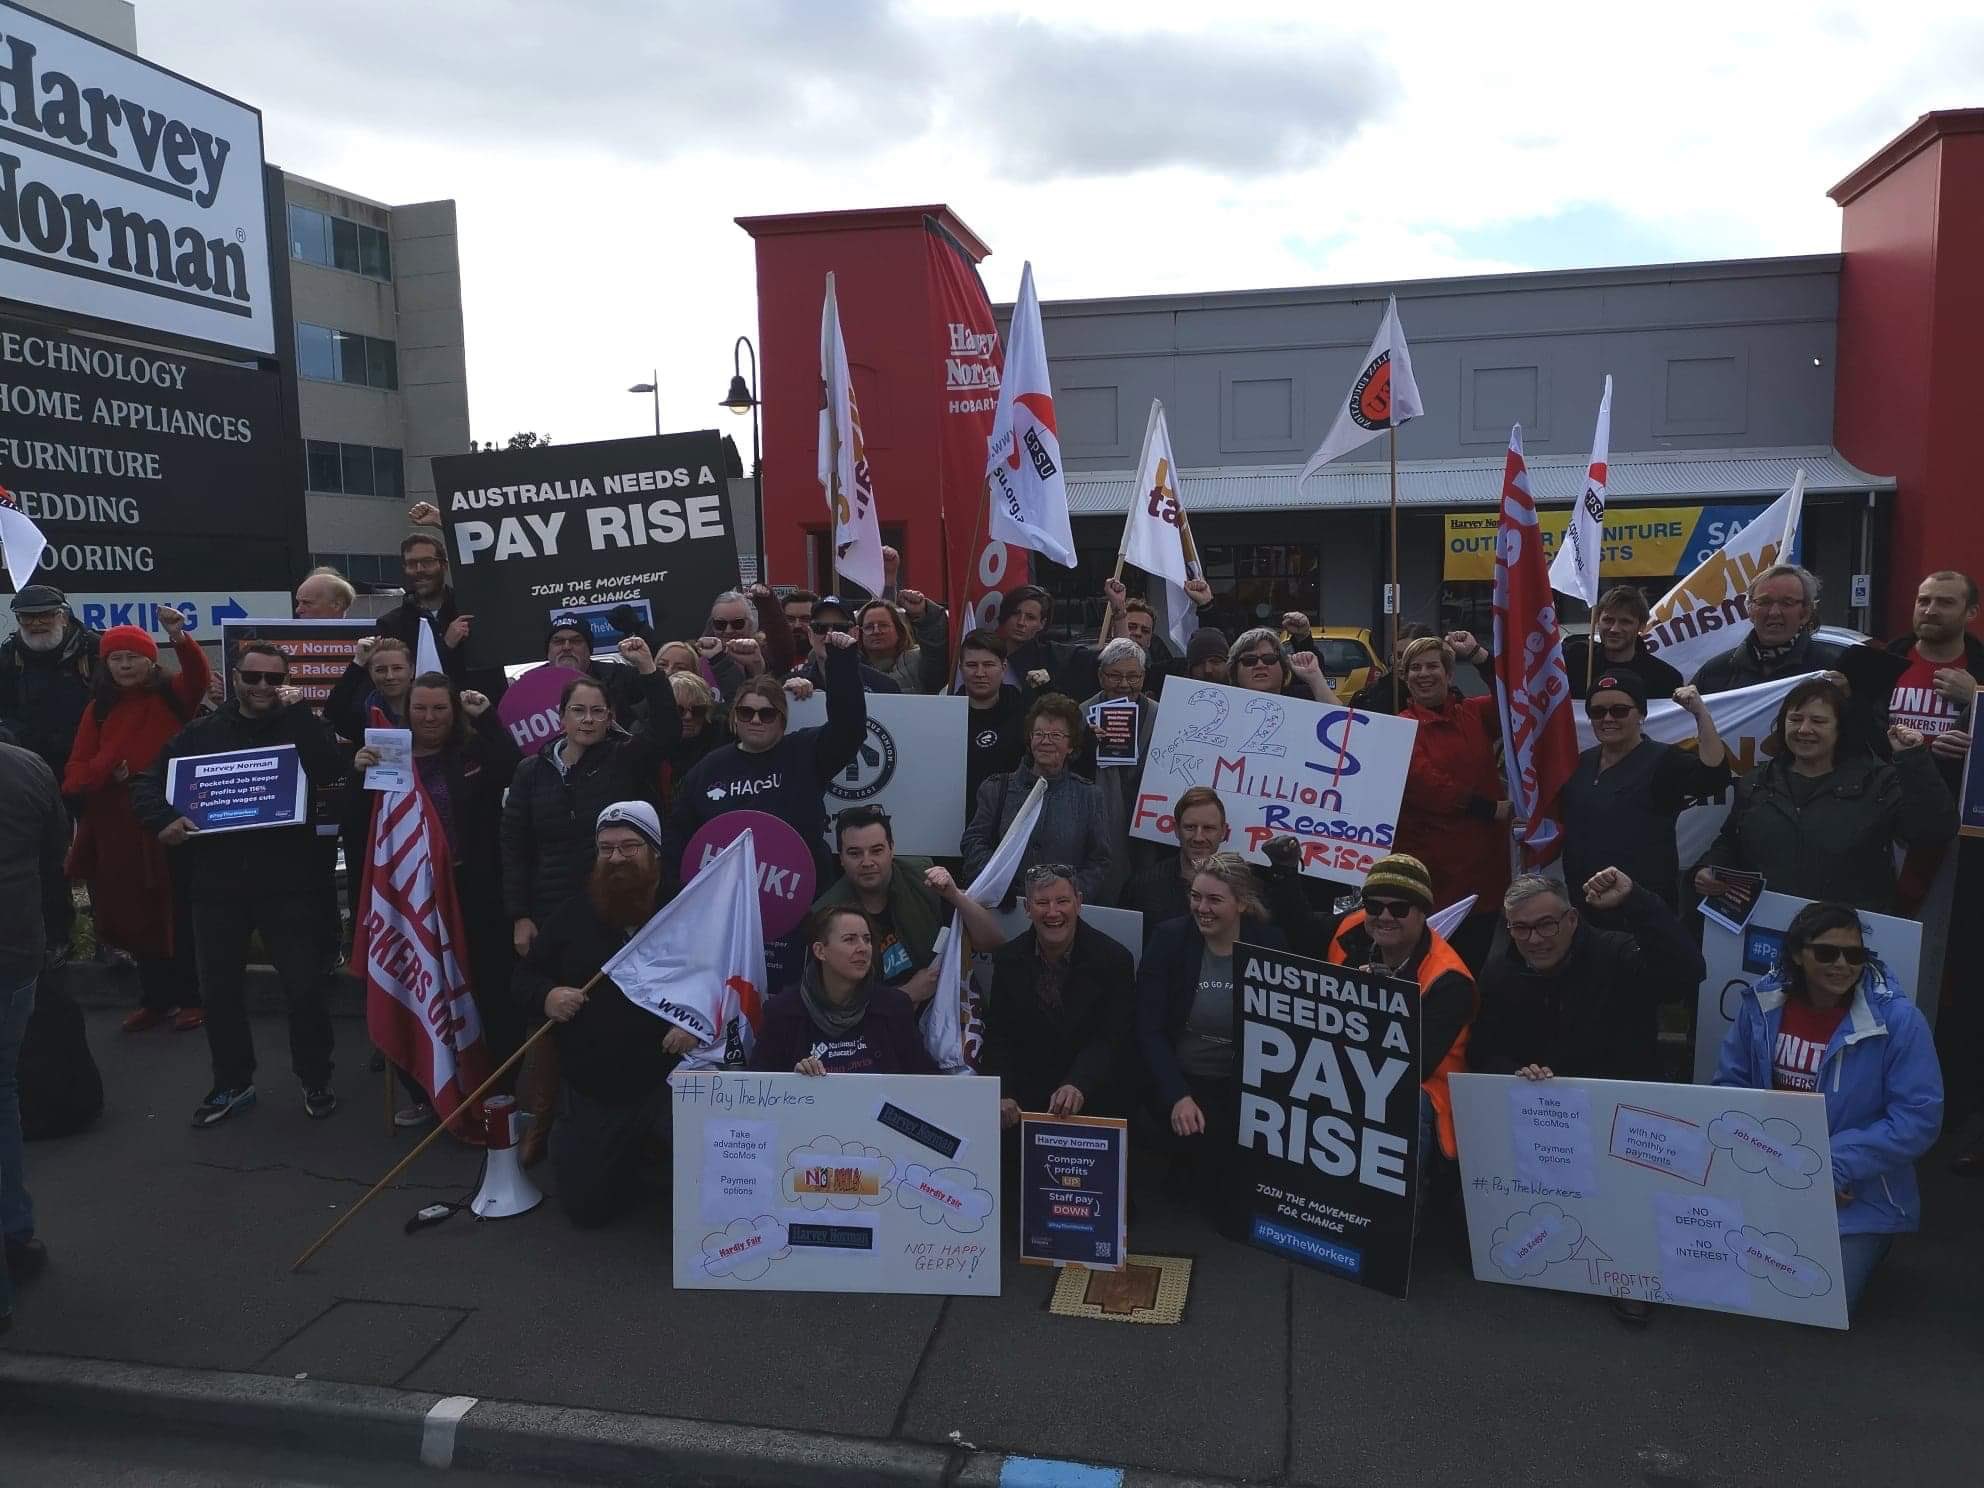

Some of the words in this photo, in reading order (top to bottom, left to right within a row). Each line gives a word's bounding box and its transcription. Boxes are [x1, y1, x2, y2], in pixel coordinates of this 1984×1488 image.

[0, 332, 187, 390] ECHNOLOGY
[92, 397, 252, 443] APPLIANCES
[451, 477, 598, 512] AUSTRALIA
[602, 466, 690, 495] NEEDS
[698, 465, 716, 485] A
[20, 490, 140, 525] EDDING
[454, 510, 567, 565] PAY
[585, 494, 726, 551] RISE
[0, 540, 155, 572] OORING
[531, 581, 564, 597] JOIN
[567, 578, 593, 593] THE
[596, 570, 668, 589] MOVEMENT
[562, 595, 590, 608] FOR
[590, 589, 641, 604] CHANGE
[83, 601, 199, 633] RKIG
[1187, 687, 1288, 757] 22
[203, 764, 235, 774] Harvey
[237, 760, 273, 770] Norman
[199, 779, 235, 789] Pocketed
[236, 777, 250, 785] Job
[251, 774, 280, 783] Keeper
[210, 788, 236, 797] Profits
[200, 799, 231, 808] Pushing
[232, 796, 258, 804] wages
[1258, 804, 1395, 846] Reasons
[1244, 957, 1410, 1017] AUSTRALIA
[1243, 984, 1369, 1042] NEEDS
[1381, 1021, 1410, 1053] A
[1242, 1019, 1410, 1124] PAY
[1538, 1097, 1560, 1107] Take
[1522, 1108, 1569, 1120] advantage
[1571, 1111, 1580, 1119] of
[1533, 1118, 1570, 1129] ScoMos
[729, 1129, 751, 1139] Take
[1629, 1125, 1648, 1137] with
[1650, 1132, 1666, 1143] NO
[1733, 1128, 1750, 1142] Job
[714, 1140, 757, 1151] advantage
[758, 1141, 767, 1150] of
[1038, 1135, 1069, 1146] Harvey
[1070, 1138, 1106, 1149] Norman
[1238, 1091, 1409, 1197] RISE
[1534, 1143, 1574, 1154] Payment
[1627, 1137, 1664, 1154] monthly
[723, 1151, 757, 1161] ScoMos
[1047, 1154, 1095, 1168] Company
[1538, 1155, 1571, 1165] options
[1625, 1148, 1671, 1166] payments
[1055, 1166, 1088, 1176] profits
[720, 1175, 757, 1186] Payment
[1064, 1176, 1080, 1186] UP
[724, 1188, 753, 1197] options
[920, 1182, 945, 1202] Hardly
[946, 1195, 962, 1208] Fair
[1049, 1192, 1073, 1201] Staff
[1076, 1194, 1094, 1204] pay
[1054, 1205, 1089, 1217] DOWN
[1255, 1183, 1283, 1200] JOIN
[1286, 1192, 1306, 1208] THE
[1309, 1198, 1372, 1227] MOVEMENT
[1692, 1207, 1710, 1217] NO
[1277, 1203, 1297, 1219] FOR
[1300, 1211, 1345, 1233] CHANGE
[1675, 1216, 1723, 1229] DEPOSIT
[719, 1241, 746, 1258] Hardly
[746, 1234, 762, 1247] Fair
[904, 1243, 933, 1254] NOT
[1257, 1223, 1357, 1267] #PayTheWorkers
[1696, 1239, 1712, 1249] NO
[1677, 1247, 1729, 1262] INTEREST
[1746, 1246, 1763, 1259] Job
[1765, 1256, 1798, 1275] Keeper
[1604, 1271, 1662, 1291] PROFITS
[1609, 1286, 1632, 1299] UP
